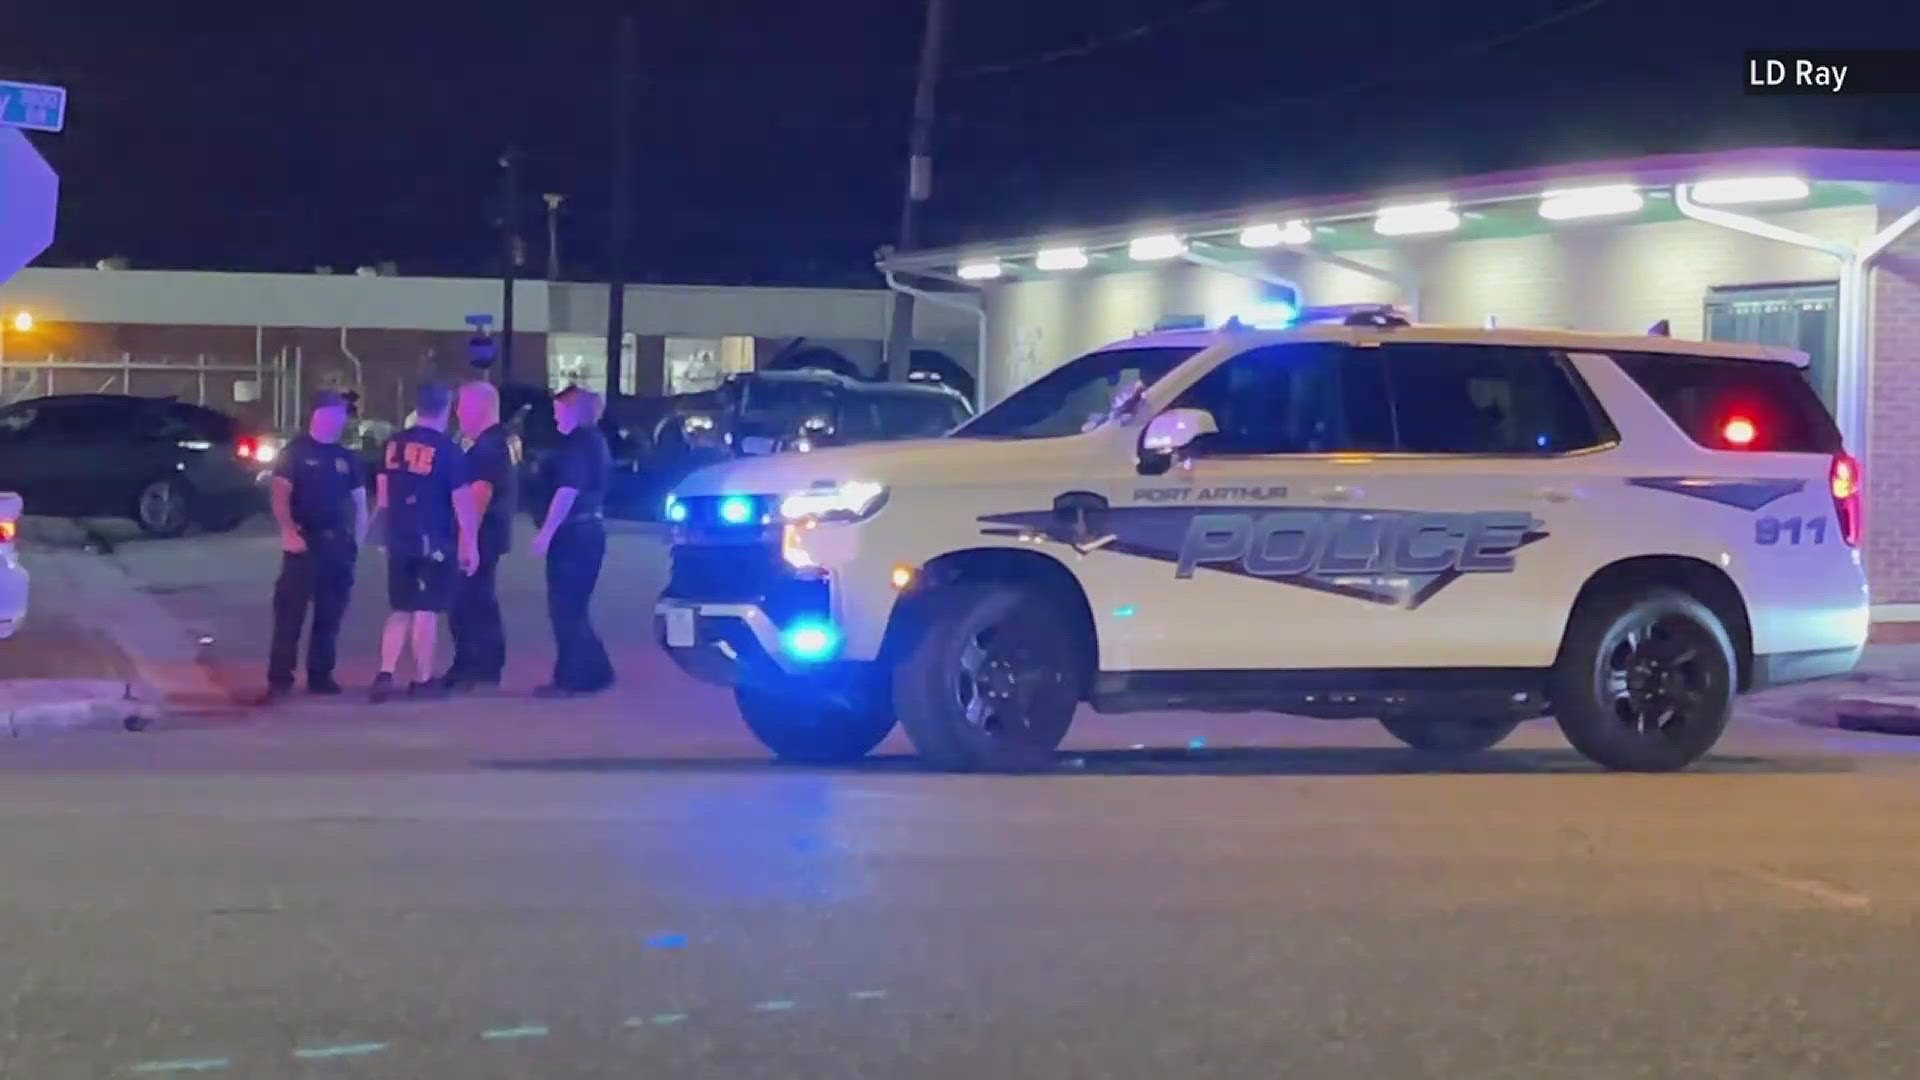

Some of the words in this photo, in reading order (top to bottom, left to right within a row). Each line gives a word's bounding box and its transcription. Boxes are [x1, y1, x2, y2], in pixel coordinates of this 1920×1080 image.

[1132, 487, 1192, 501] PORT
[1197, 486, 1288, 500] ARTHUR
[1755, 516, 1827, 545] 911
[1175, 512, 1532, 579] POLICE
